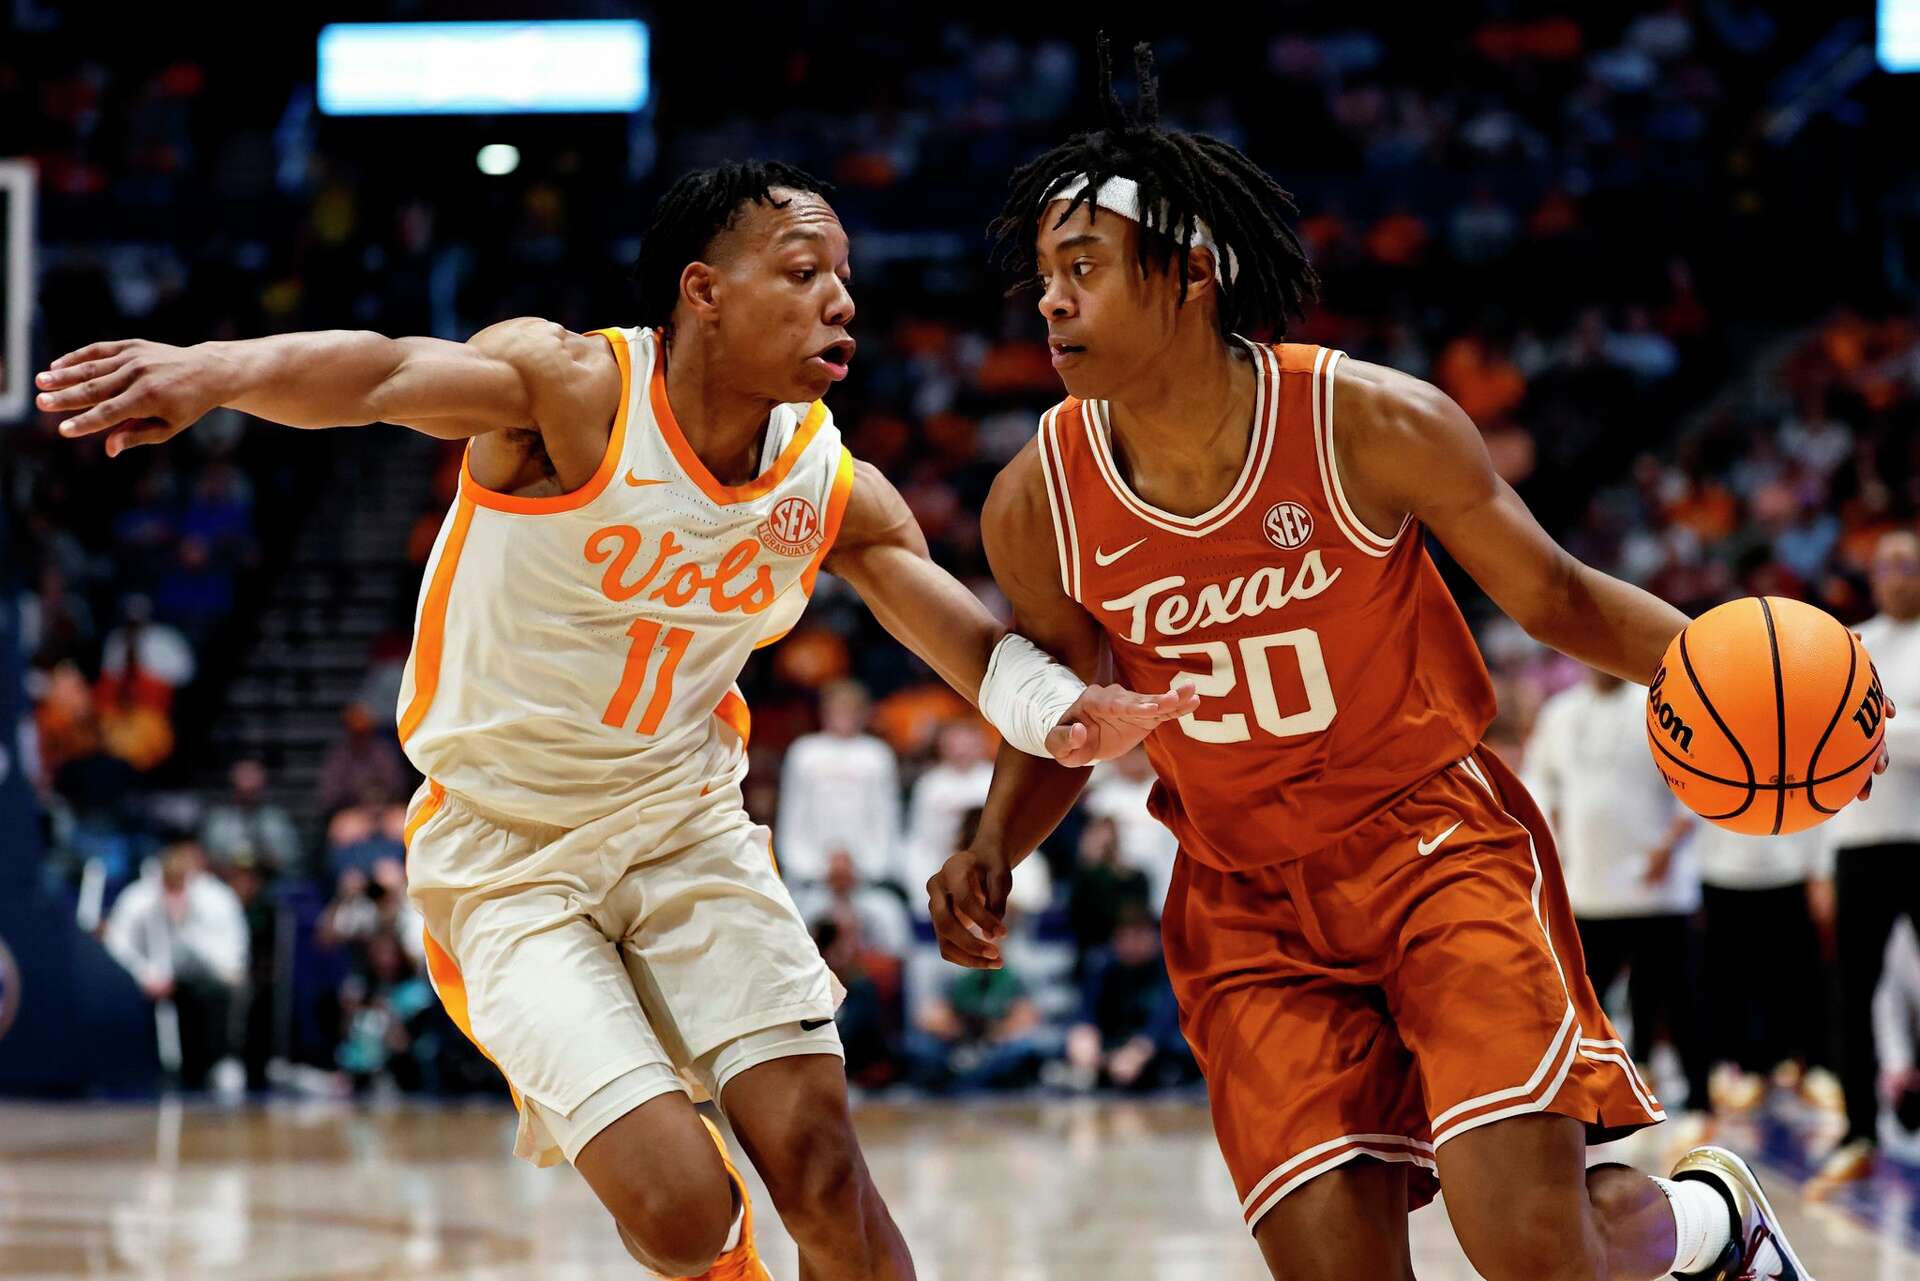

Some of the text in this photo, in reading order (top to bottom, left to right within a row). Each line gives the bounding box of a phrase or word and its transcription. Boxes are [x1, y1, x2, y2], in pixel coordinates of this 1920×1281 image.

[763, 534, 813, 554] GRADUATE
[772, 500, 815, 541] SEC
[1266, 505, 1310, 546] SEC
[583, 524, 776, 614] Vols
[1102, 550, 1342, 644] Texas
[601, 617, 695, 736] 11
[1154, 627, 1338, 744] 20
